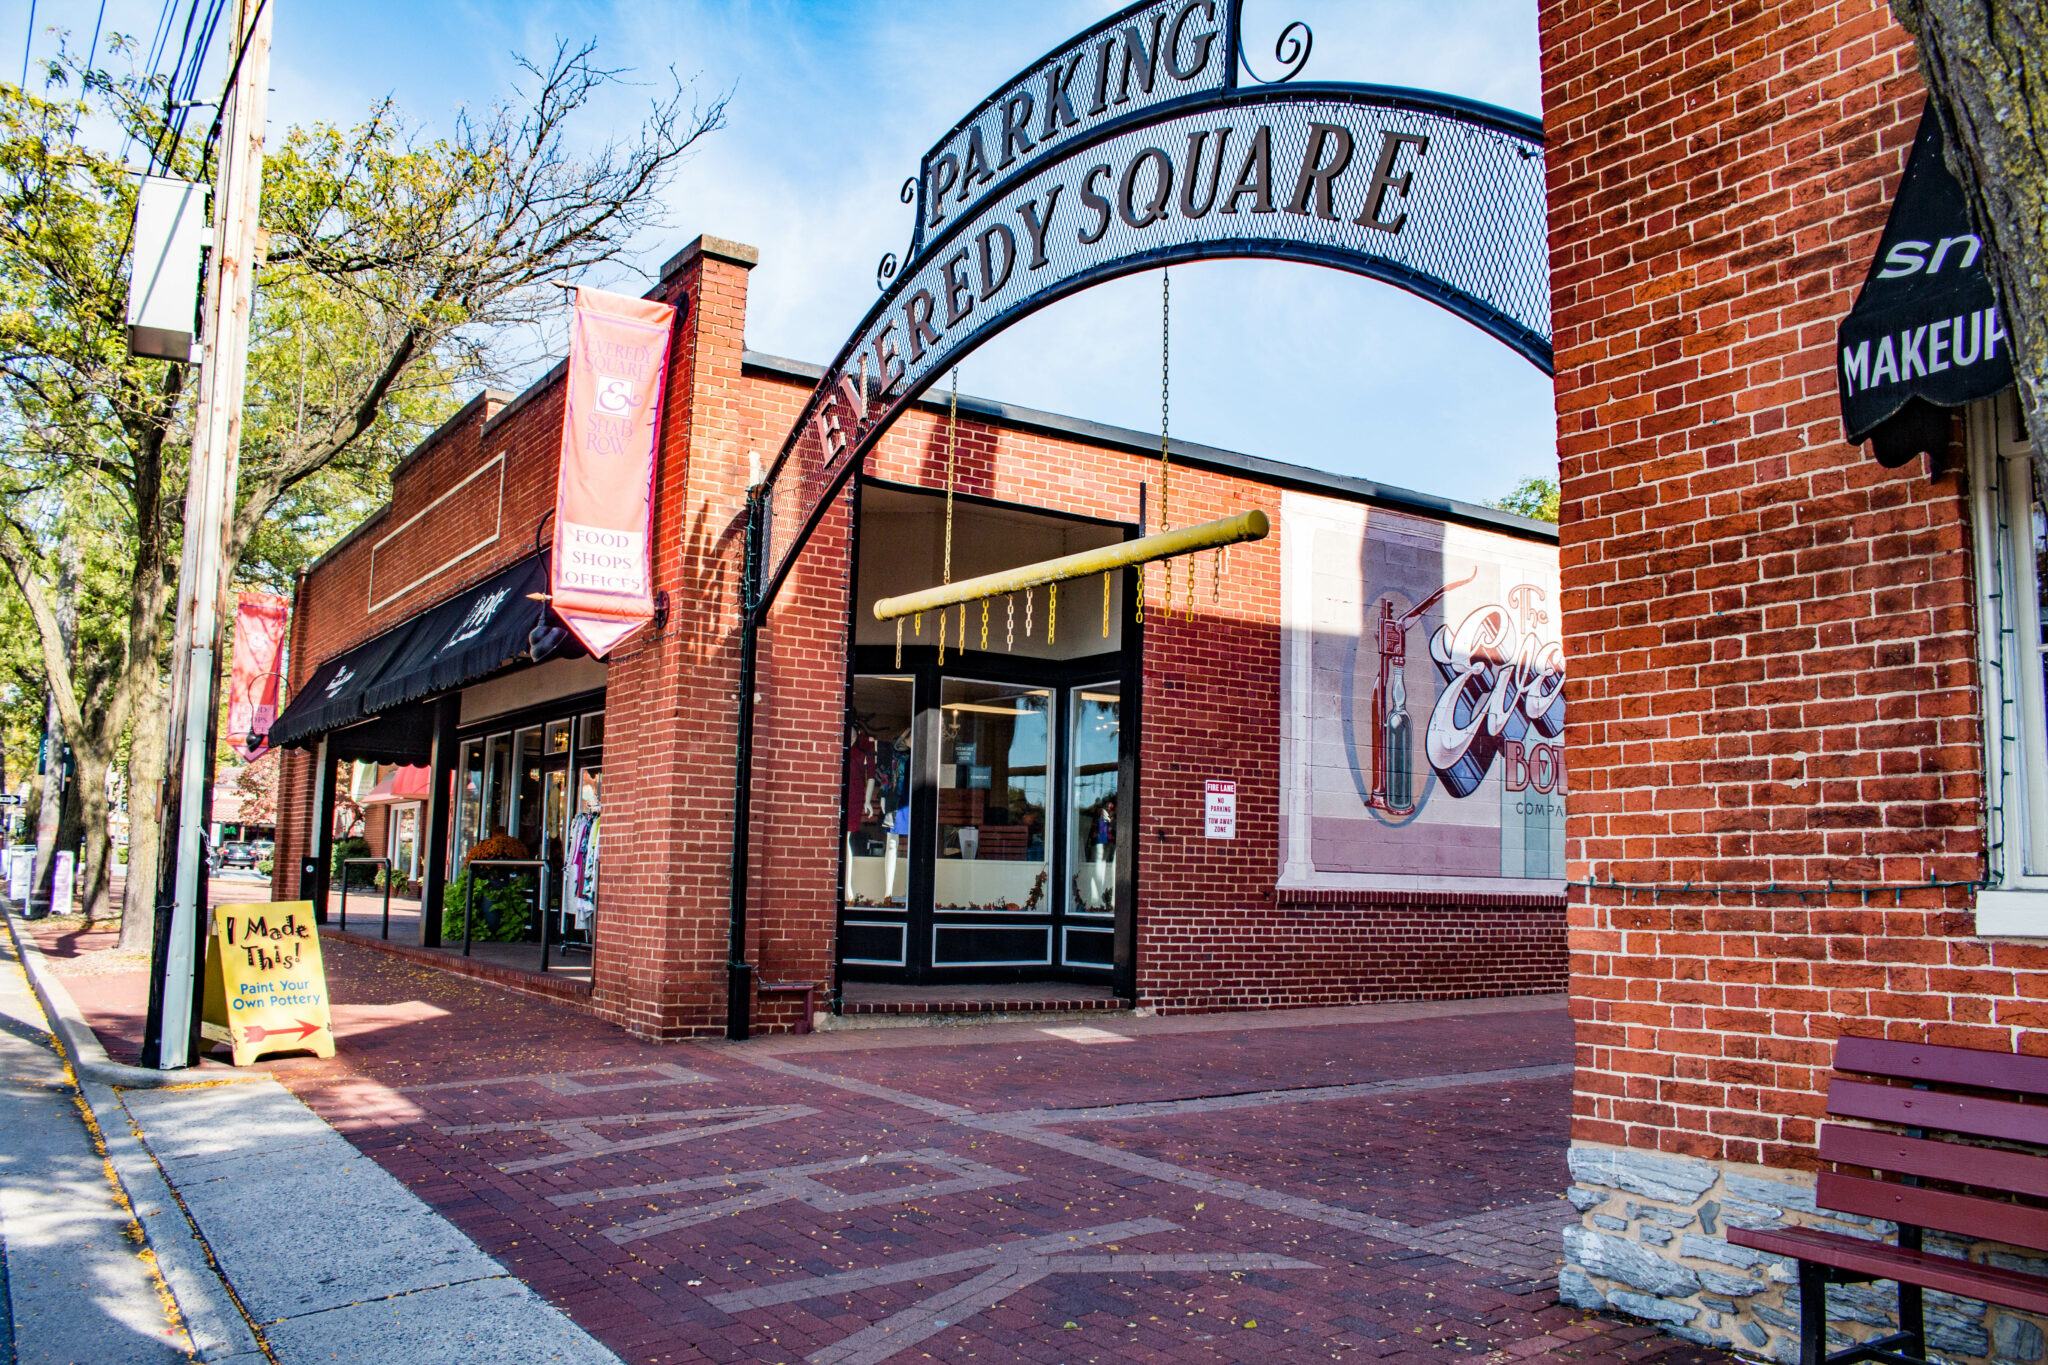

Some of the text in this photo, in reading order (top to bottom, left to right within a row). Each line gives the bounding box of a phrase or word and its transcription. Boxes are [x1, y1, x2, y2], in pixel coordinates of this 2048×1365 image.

[928, 1, 1217, 228] PARKING
[813, 121, 1431, 469] EVEREDY SQUARE
[584, 333, 657, 364] EVEREDY
[583, 352, 651, 382] SQUARE
[598, 381, 644, 411] &
[587, 413, 632, 438] SHAB
[586, 432, 631, 456] ROW
[576, 529, 629, 548] FOOD
[572, 550, 631, 569] SHOPS
[565, 571, 640, 590] OFFICES
[1508, 584, 1549, 634] The
[1207, 783, 1234, 792] FIRE LANE
[226, 914, 310, 945] I Made
[241, 942, 301, 971] This!
[240, 980, 310, 995] Paint Your
[233, 995, 320, 1010] Own Pottery
